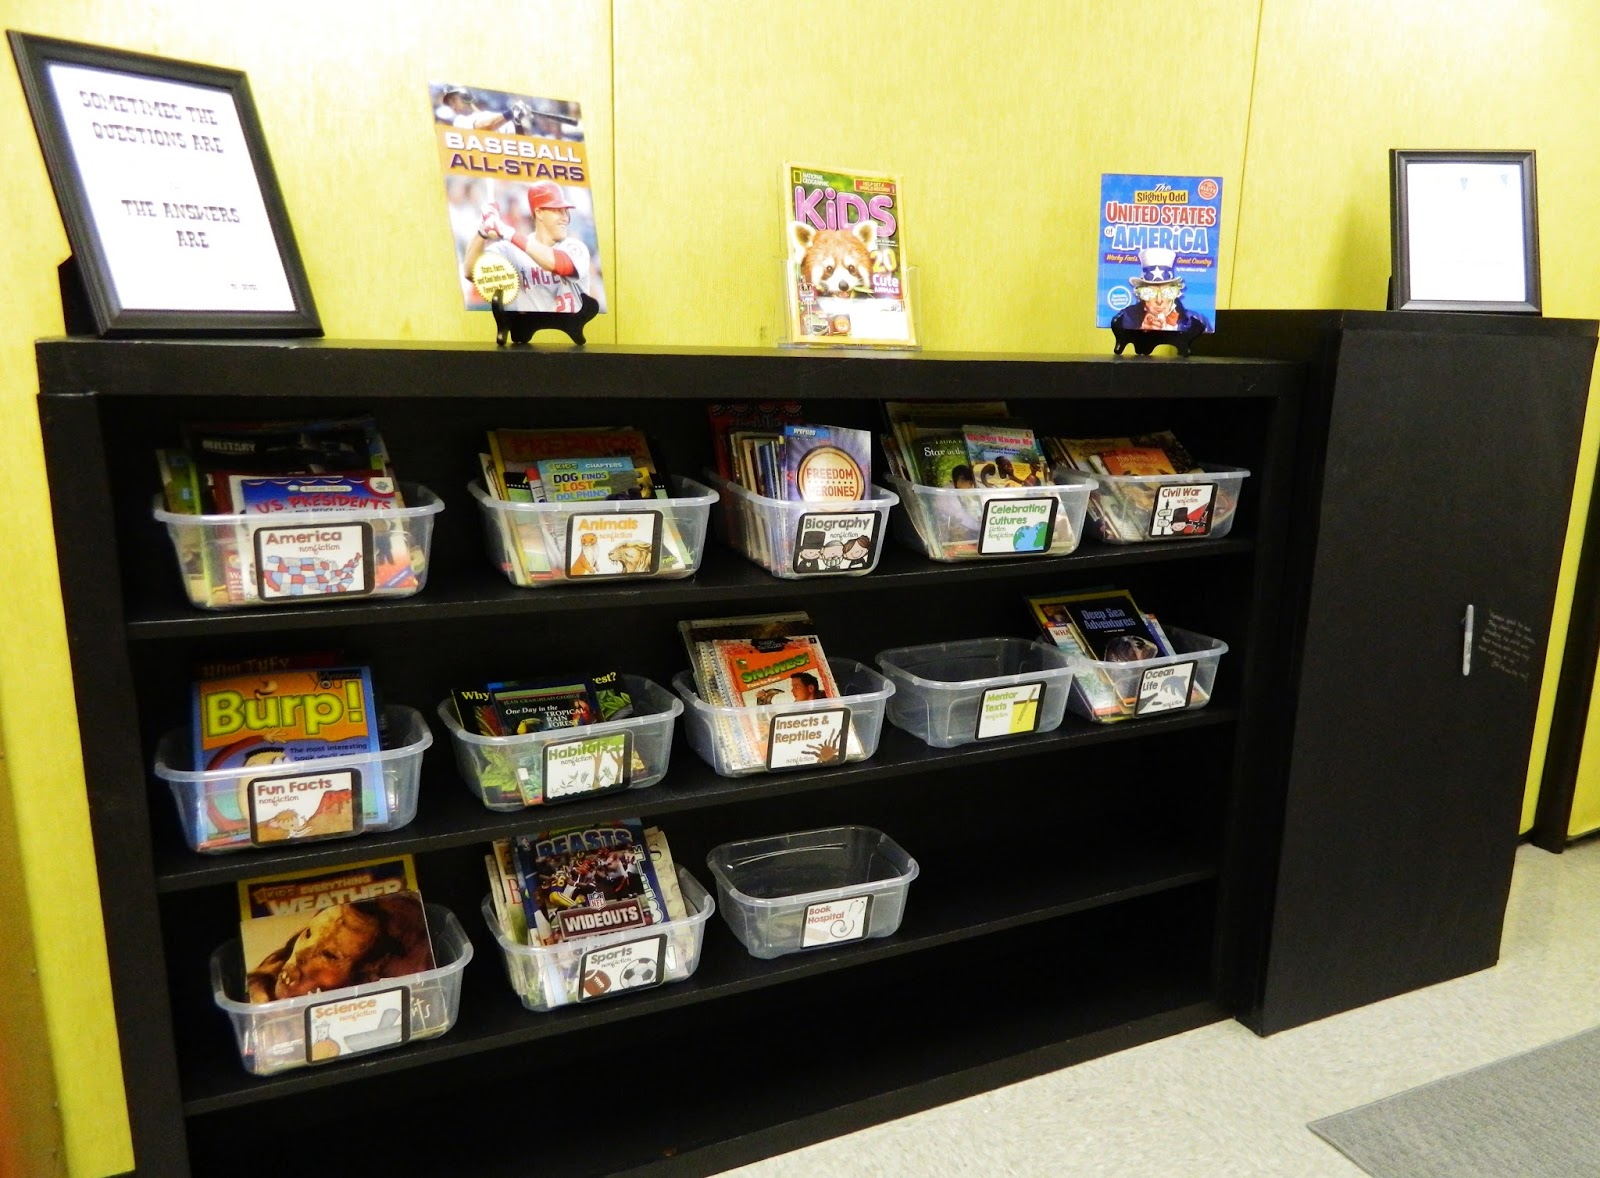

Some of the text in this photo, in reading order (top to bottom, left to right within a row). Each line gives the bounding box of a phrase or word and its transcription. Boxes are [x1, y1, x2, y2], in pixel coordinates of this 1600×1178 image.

[79, 90, 218, 126] SOMETIMES THE
[92, 121, 224, 153] QUESTIONS ARE
[445, 131, 582, 163] BASEBALL
[450, 153, 585, 182] ALL-STARS
[802, 172, 823, 180] NATIONAL
[1154, 183, 1171, 192] The
[1137, 191, 1186, 204] Slightly Odd
[121, 199, 241, 223] THE ANSWERS
[1105, 201, 1216, 226] UNITED STATES
[176, 230, 210, 248] ARE
[870, 248, 897, 273] 20
[873, 274, 899, 288] Cute
[874, 286, 899, 294] ANIMALS
[555, 291, 575, 313] 27
[202, 440, 256, 453] MILITARY
[997, 436, 1020, 444] Know
[923, 447, 945, 457] Star
[553, 472, 607, 484] DOG FINDS
[806, 468, 854, 480] FREEDOM
[562, 481, 594, 492] LOST
[1162, 487, 1202, 497] Civil War
[256, 494, 391, 514] U.S. PRESIDENTS
[990, 504, 1047, 514] Celebrating
[578, 518, 639, 531] Animals
[804, 516, 871, 532] Biography
[989, 516, 1027, 526] Cultures
[266, 530, 342, 546] America
[599, 531, 633, 542] nonfiction
[830, 532, 858, 541] nonfiction
[298, 542, 341, 555] nonfiction
[1081, 607, 1126, 623] Deep Sea
[1084, 617, 1137, 630] Adventures
[1145, 668, 1175, 680] Ocean
[1142, 681, 1158, 691] Life
[461, 689, 490, 702] Why
[986, 692, 1018, 702] Mentor
[204, 680, 364, 738] Burp!
[545, 708, 585, 717] TROPICAL
[985, 703, 1007, 712] Texts
[775, 715, 830, 730] Insects &
[774, 730, 822, 744] Reptiles
[327, 743, 368, 751] interesting
[548, 743, 608, 761] Habitats
[560, 755, 593, 766] nonfiction
[786, 755, 814, 765] nonfiction
[257, 777, 333, 796] Fun Facts
[258, 795, 300, 806] nonfiction
[536, 828, 633, 857] BEASTS
[301, 875, 371, 894] EVERYTHING
[590, 899, 604, 907] NFL
[809, 906, 831, 916] Book
[564, 906, 639, 932] WIDEOUTS
[808, 912, 845, 924] Hospital
[590, 947, 633, 964] Sports
[601, 959, 632, 968] nonfiction
[315, 999, 376, 1019] Science
[339, 1009, 377, 1022] nonfiction
